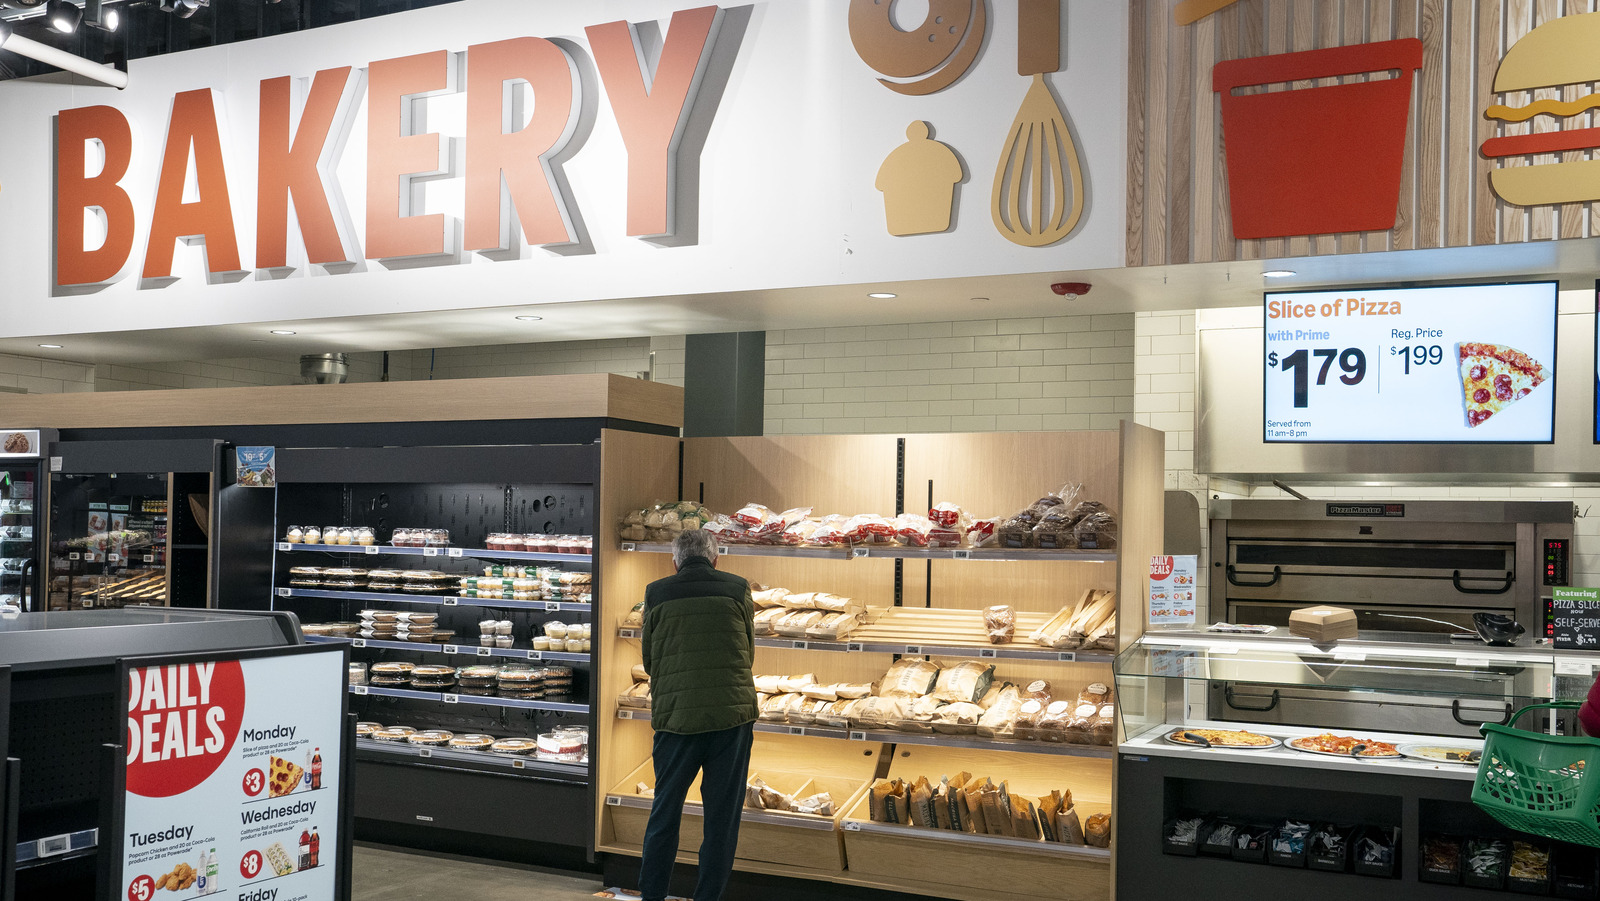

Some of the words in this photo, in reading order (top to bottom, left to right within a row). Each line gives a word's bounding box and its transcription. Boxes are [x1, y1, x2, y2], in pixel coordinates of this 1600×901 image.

[56, 4, 717, 287] BAKERY
[1268, 300, 1316, 318] Slice
[1320, 298, 1343, 318] of
[1346, 298, 1402, 316] Pizza
[1268, 330, 1293, 341] with
[1296, 329, 1330, 341] Prime
[1391, 328, 1414, 340] Reg.
[1416, 328, 1443, 338] Price
[1268, 420, 1292, 428] Served
[1294, 420, 1312, 428] from
[1150, 556, 1168, 565] DAILY
[1150, 565, 1170, 574] DEALS
[1556, 590, 1597, 598] Featuring
[1553, 600, 1575, 609] PIZZA
[1554, 618, 1600, 628] SELF-SERVE
[1576, 634, 1596, 645] $1.99
[128, 661, 216, 712] DAILY
[127, 706, 225, 766] DEALS
[243, 724, 296, 743] Monday
[245, 772, 260, 793] $3
[241, 800, 316, 825] Wednesday
[130, 825, 194, 847] Tuesday
[241, 827, 260, 835] California
[240, 834, 257, 842] product
[129, 850, 149, 860] Popcorn
[192, 837, 215, 846] Coca-Cola
[128, 857, 148, 866] product
[243, 853, 258, 874] $8
[132, 879, 149, 901] $5
[239, 888, 278, 901] Friday
